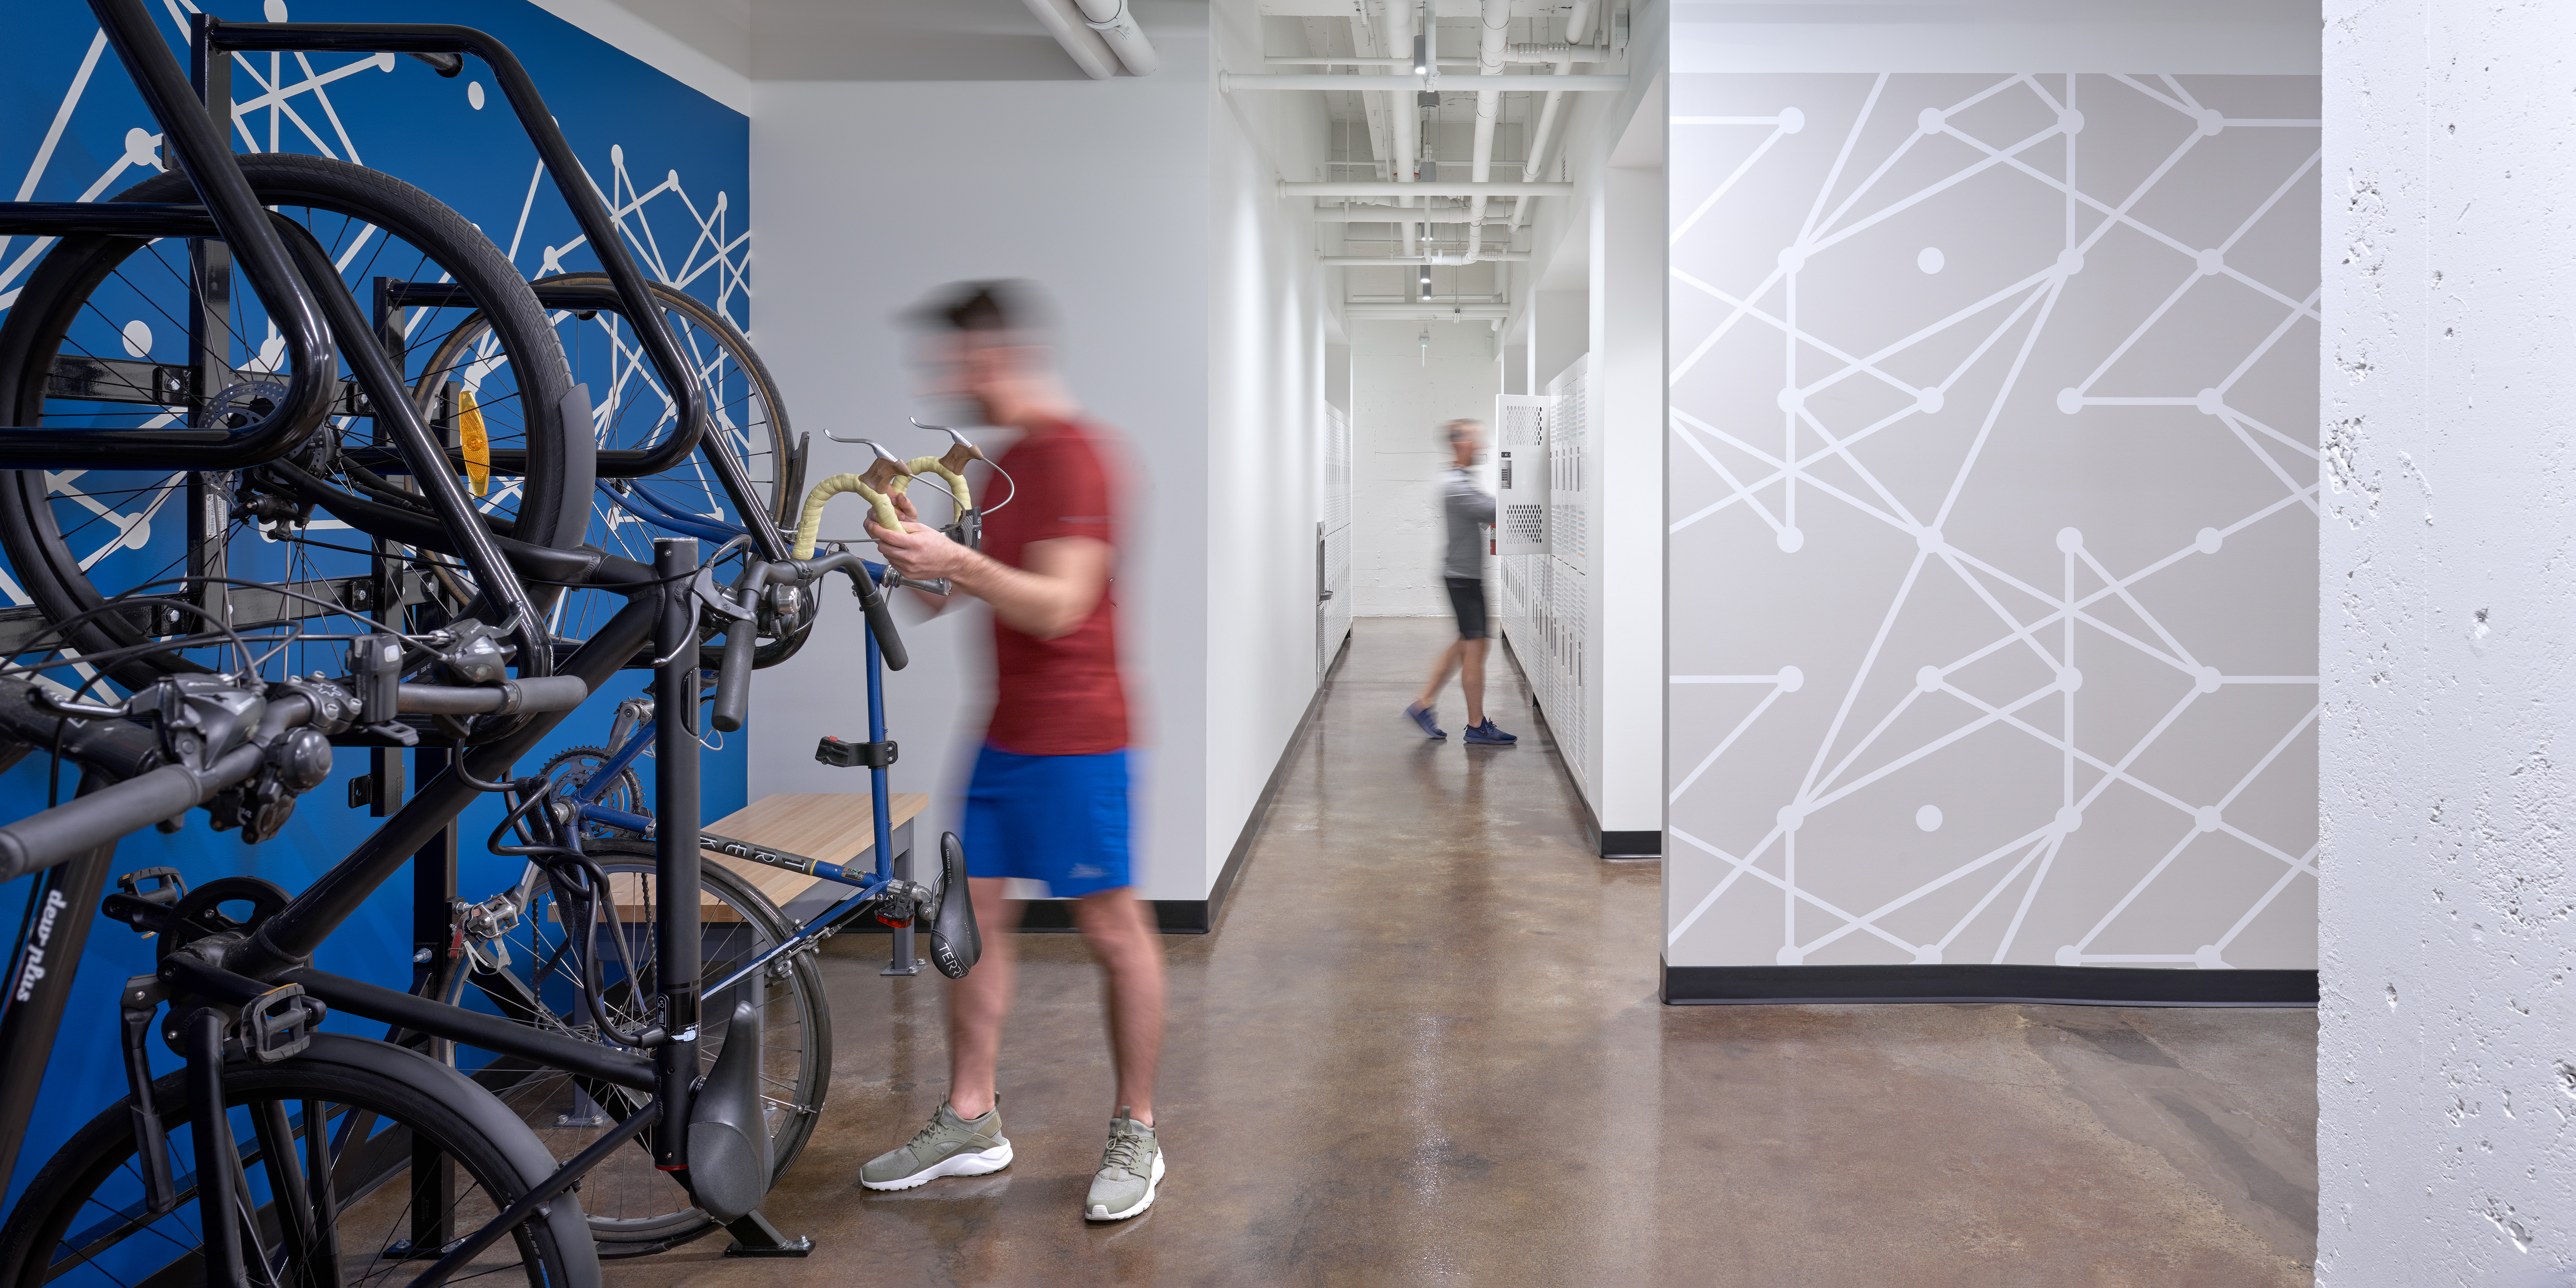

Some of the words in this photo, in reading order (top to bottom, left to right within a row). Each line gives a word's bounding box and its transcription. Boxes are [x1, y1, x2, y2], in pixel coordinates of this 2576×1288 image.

[700, 836, 806, 871] TREK
[37, 889, 68, 947] dew
[16, 943, 46, 1002] plus
[938, 942, 966, 979] TERRY
[196, 1099, 226, 1271] VANMOOF
